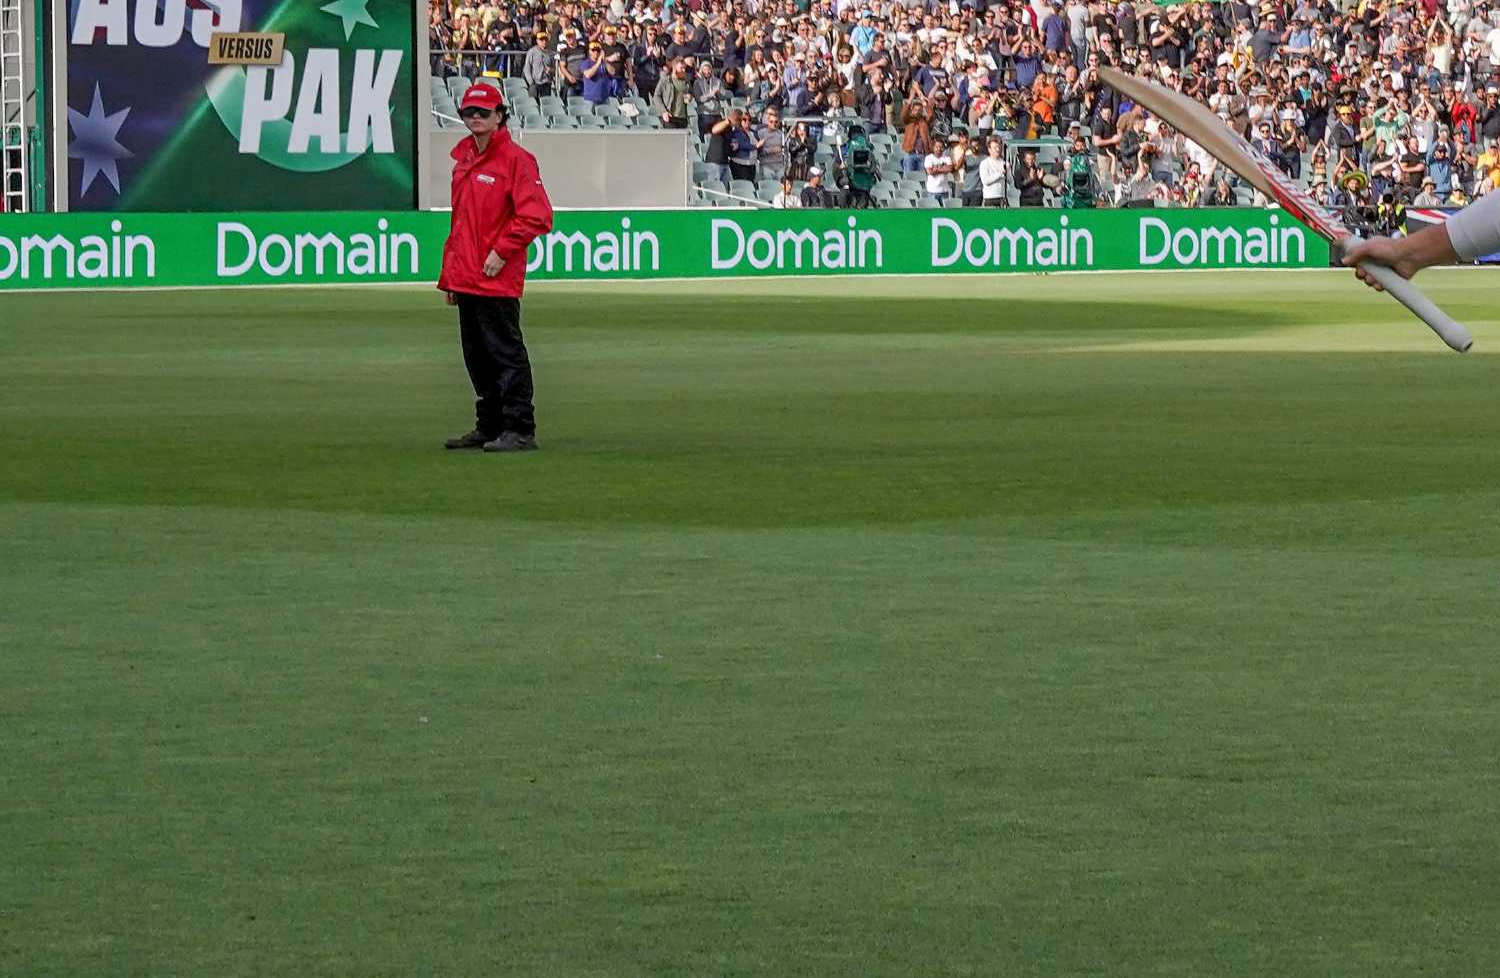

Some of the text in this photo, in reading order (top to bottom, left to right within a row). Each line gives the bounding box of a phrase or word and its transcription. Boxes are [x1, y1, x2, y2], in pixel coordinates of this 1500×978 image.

[218, 37, 273, 60] VERSUS
[239, 47, 404, 155] PAK
[0, 214, 1305, 280] omain Domain omain Domain Domain Domain
